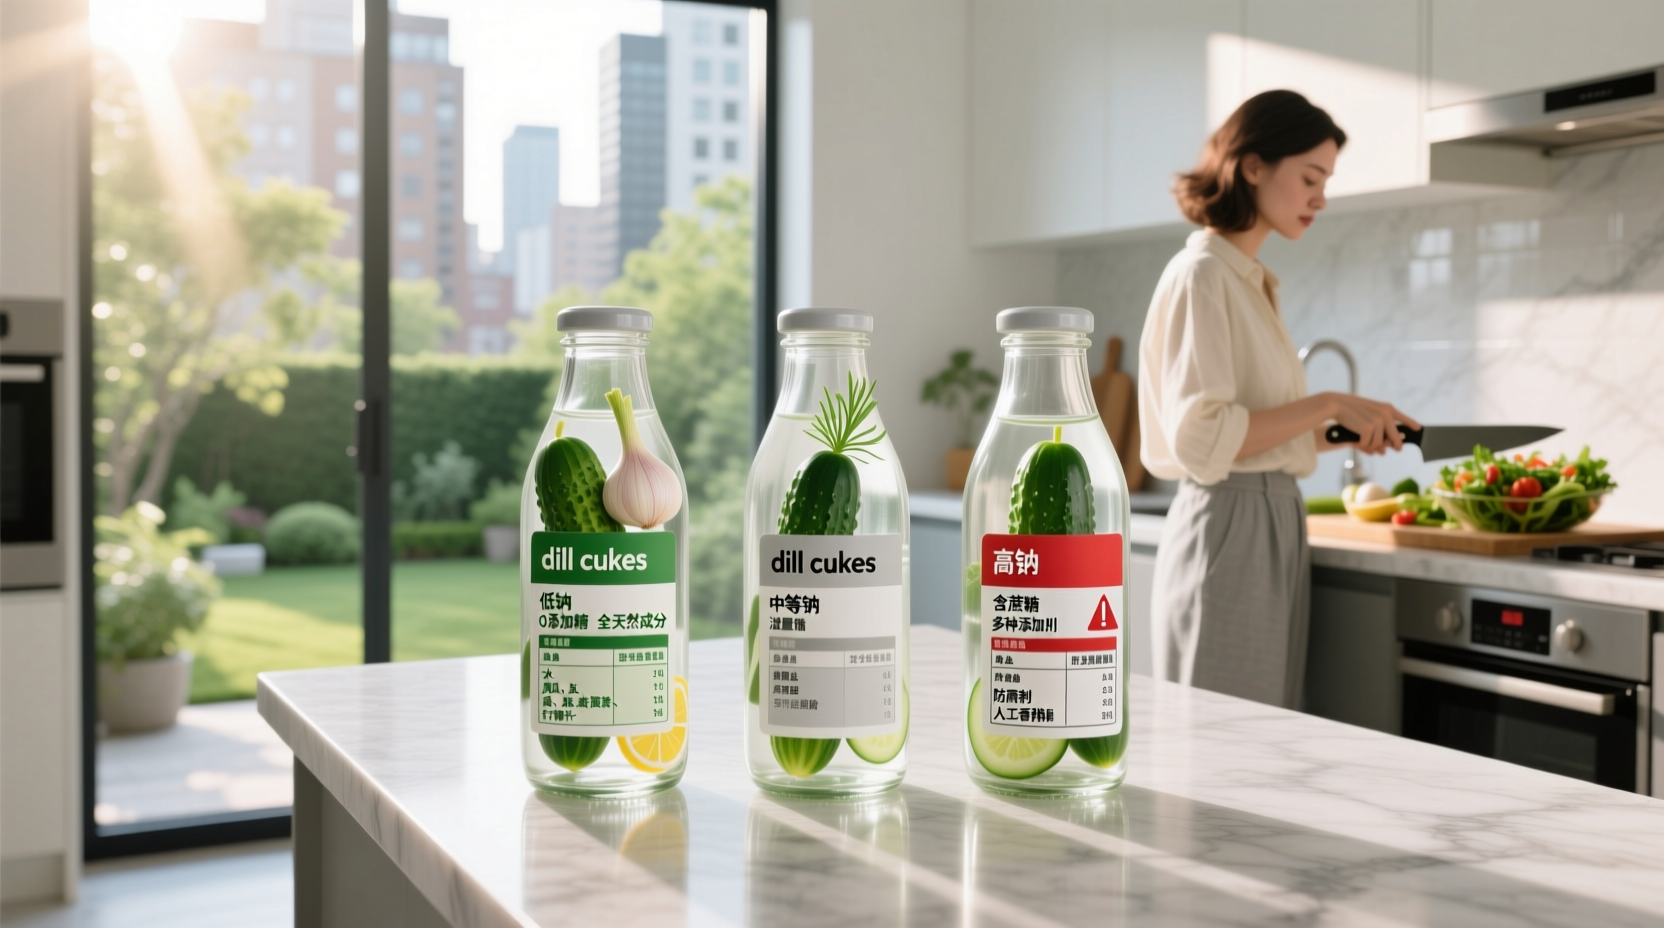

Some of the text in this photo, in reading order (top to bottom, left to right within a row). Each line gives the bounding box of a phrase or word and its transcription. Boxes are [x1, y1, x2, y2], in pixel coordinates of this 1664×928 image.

[541, 546, 648, 571] dill cukes
[771, 549, 876, 574] dill cukes
[993, 548, 1039, 575] 高钠
[539, 591, 572, 611] 低钠
[769, 593, 820, 614] 中等钠
[993, 594, 1040, 613] 含蔗糖
[597, 612, 667, 630] 全天然成分
